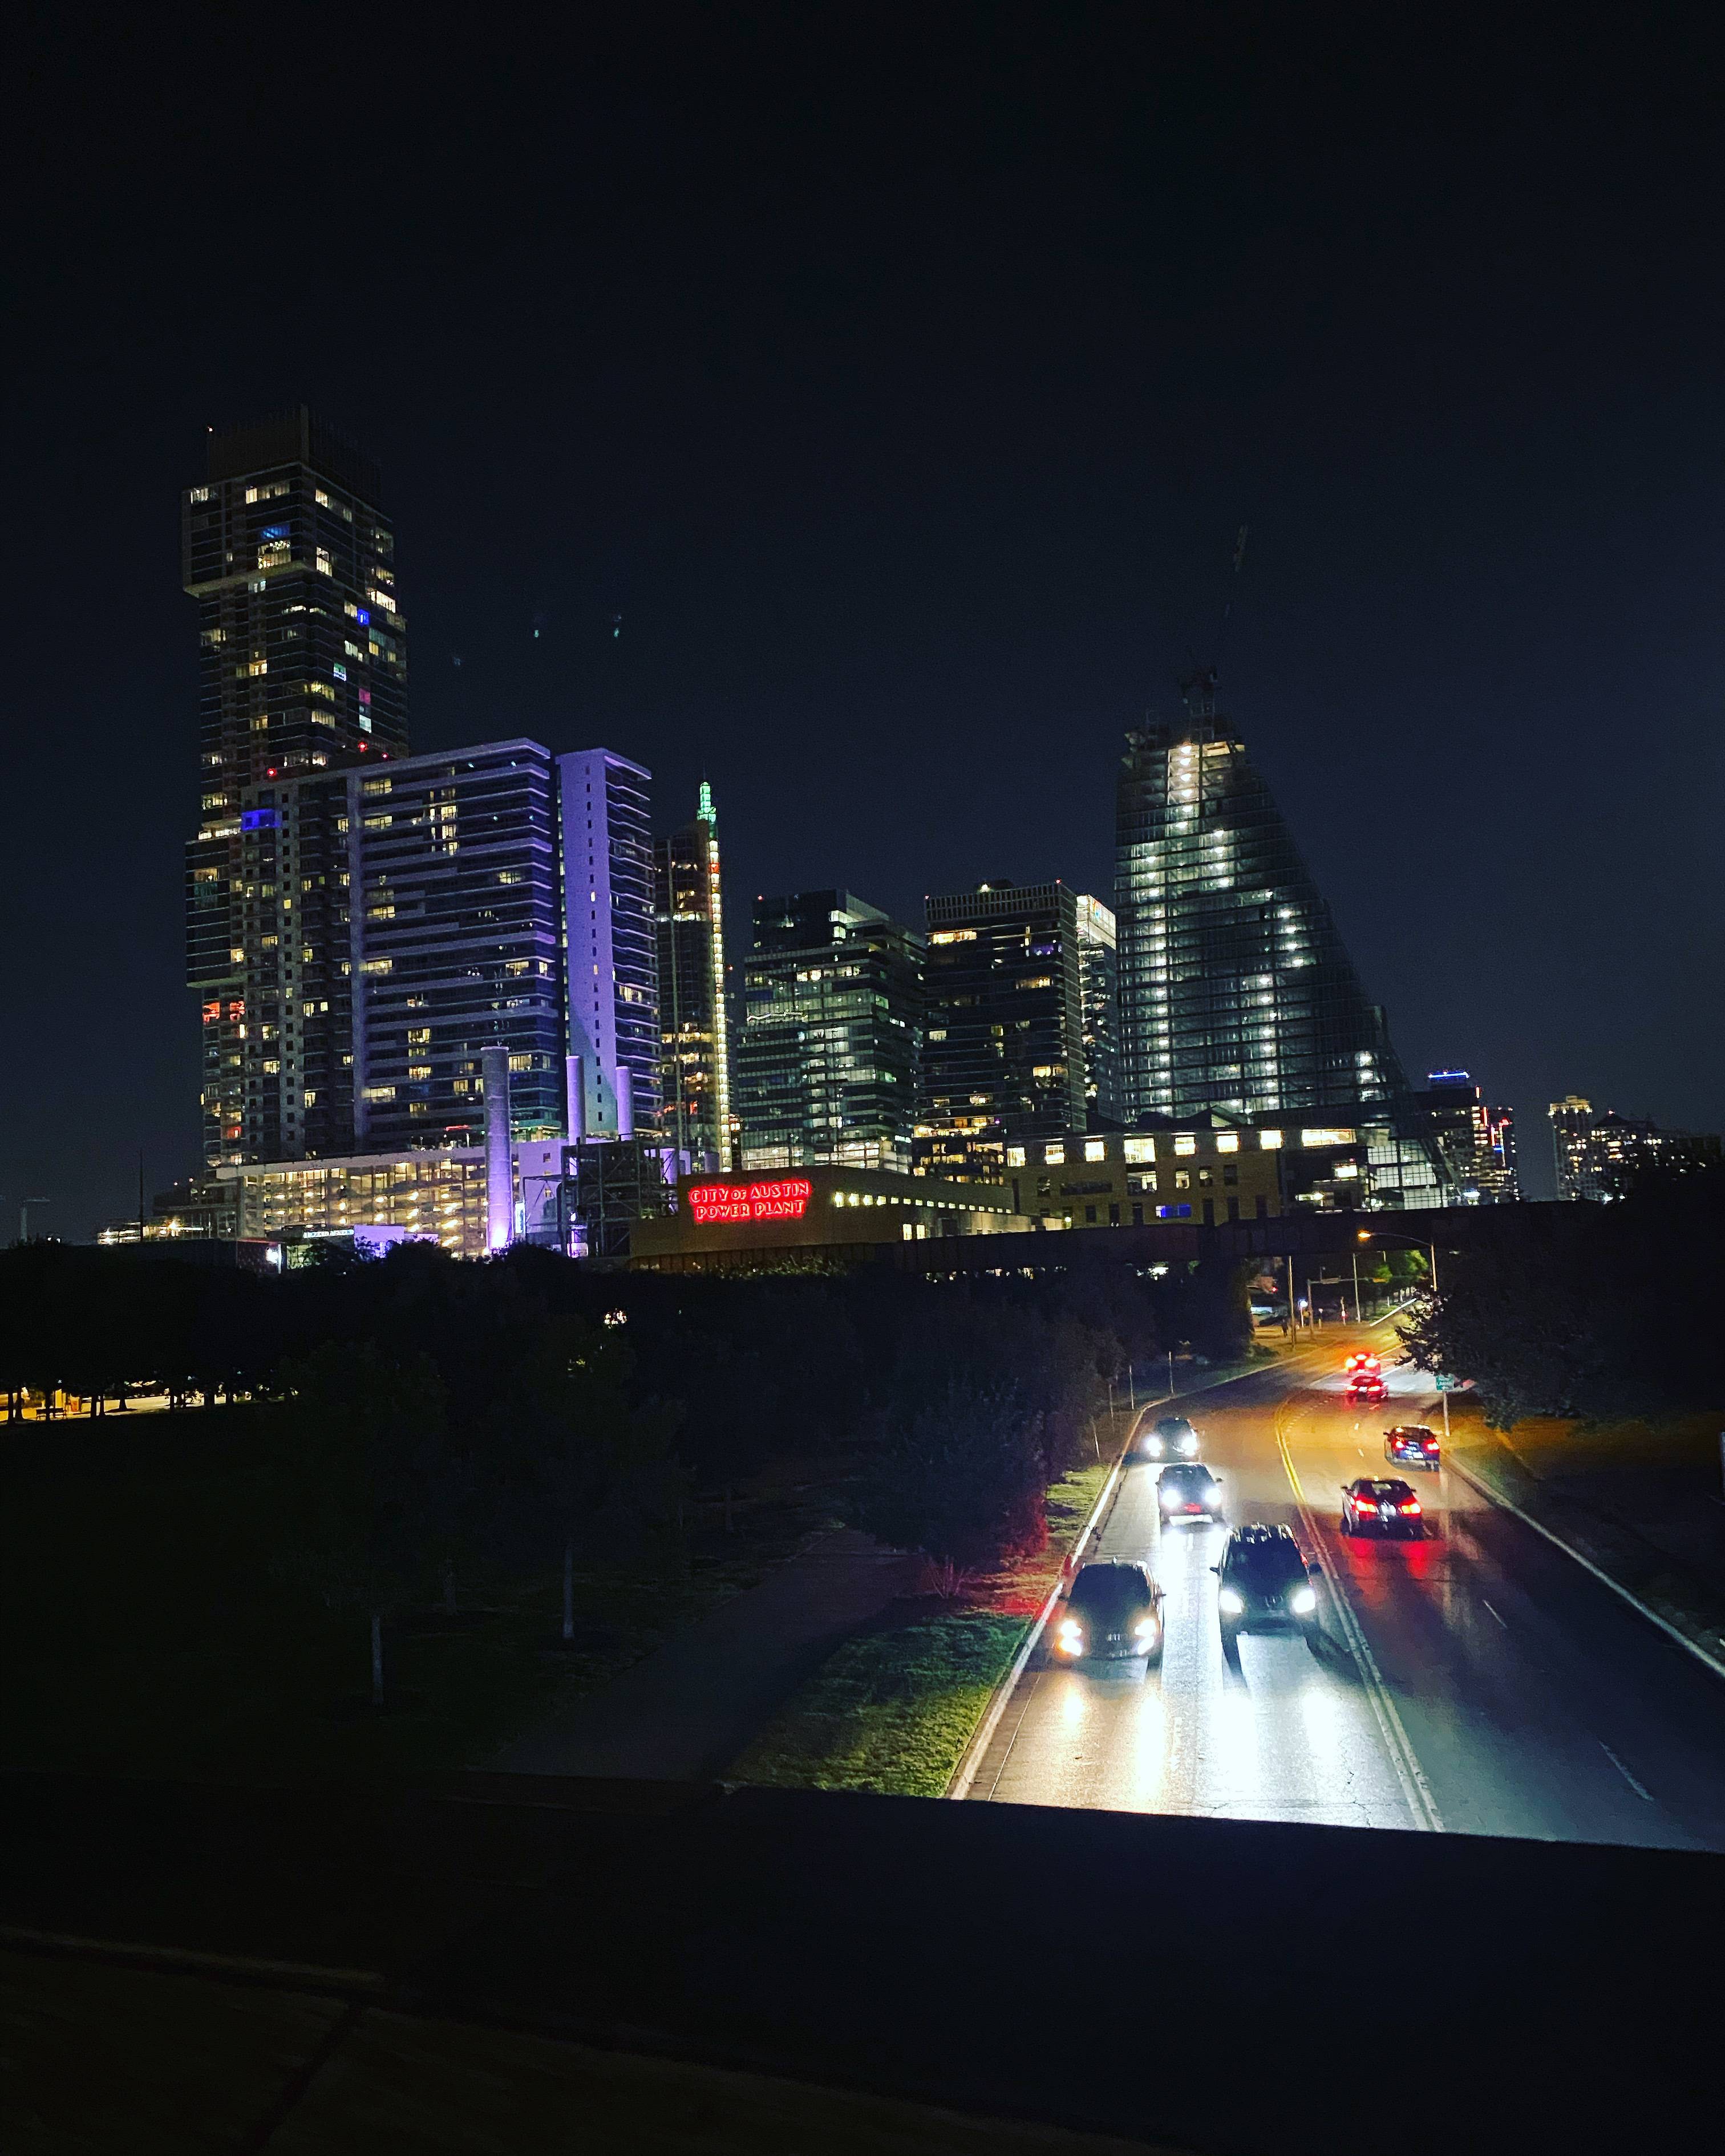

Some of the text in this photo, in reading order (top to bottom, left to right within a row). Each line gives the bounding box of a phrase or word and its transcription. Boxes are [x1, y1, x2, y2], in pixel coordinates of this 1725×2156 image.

[689, 1188, 728, 1203] CITY
[751, 1182, 808, 1198] AUSTIN
[697, 1199, 804, 1219] POWER PLANT
